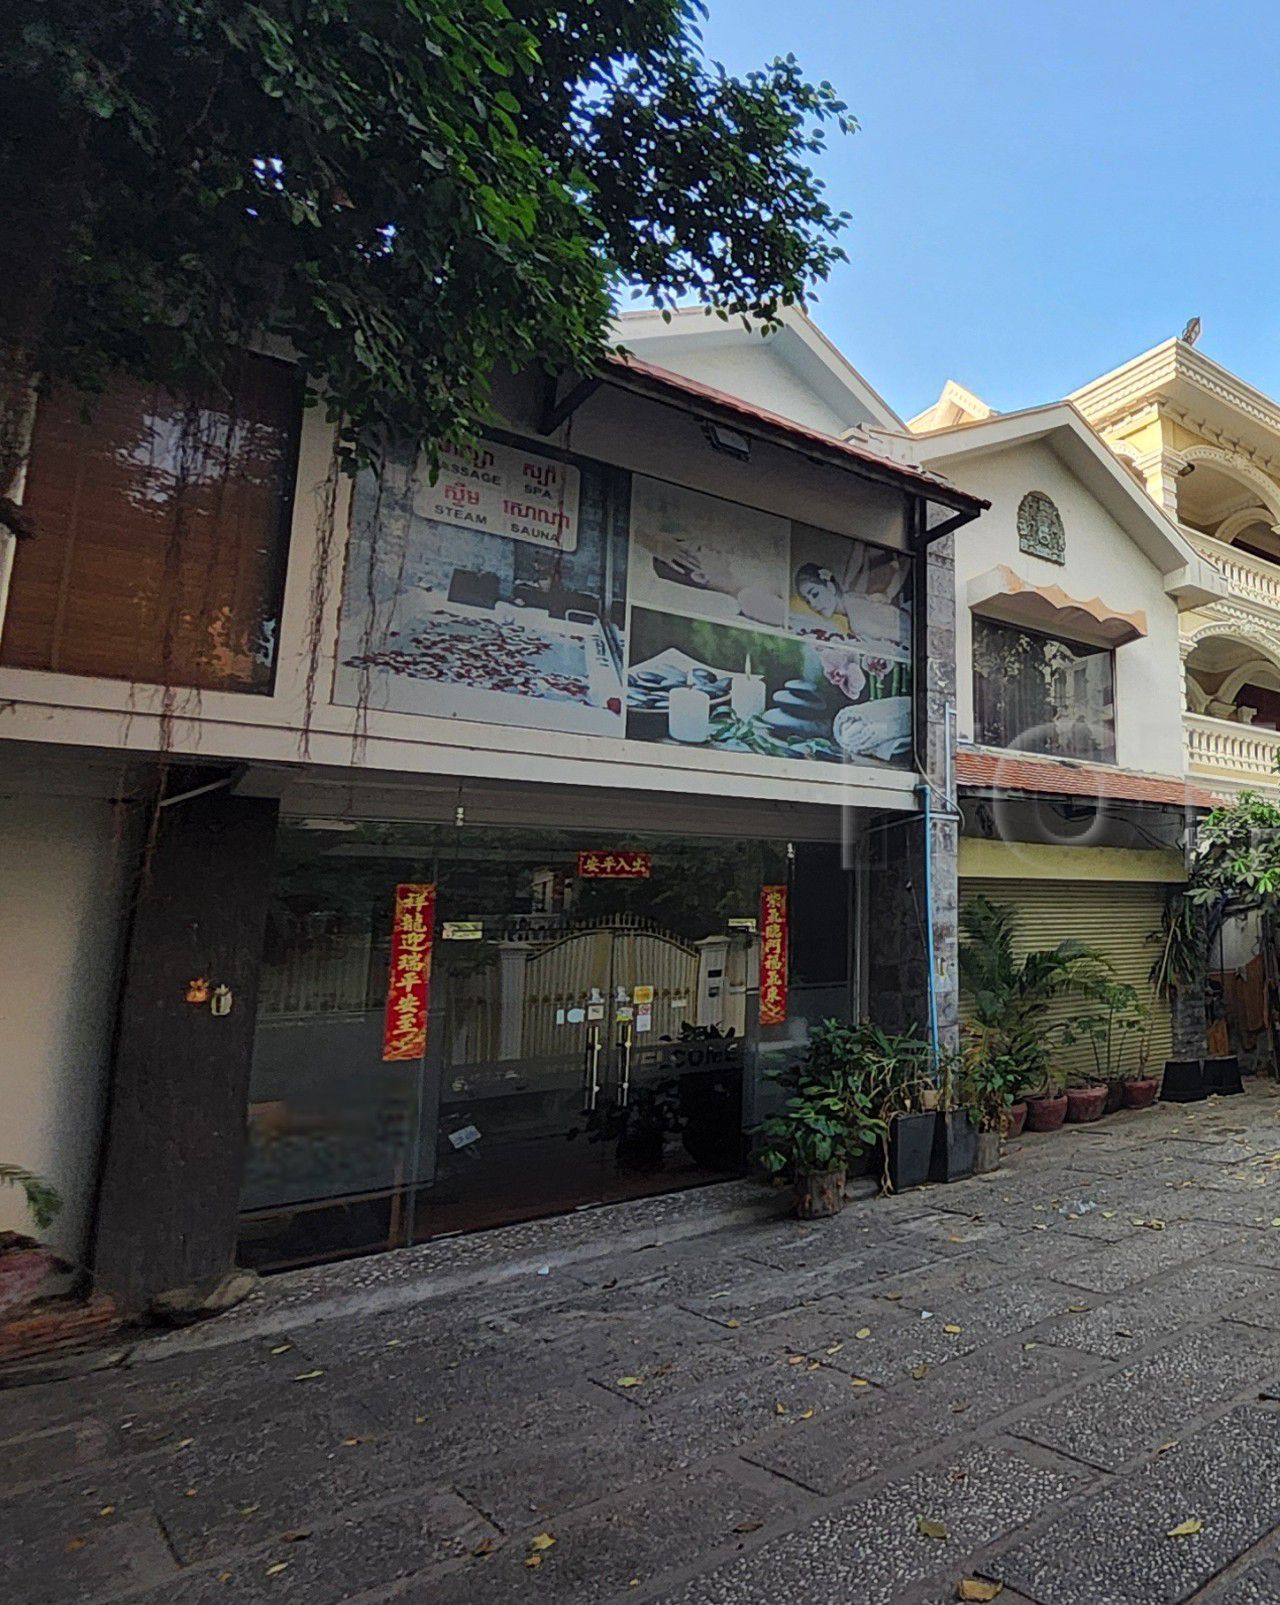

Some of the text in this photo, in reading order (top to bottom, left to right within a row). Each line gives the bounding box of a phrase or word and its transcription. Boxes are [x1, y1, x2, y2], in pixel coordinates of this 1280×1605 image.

[523, 484, 552, 500] SPA
[434, 504, 488, 525] STEAM
[510, 523, 561, 546] SAUNA
